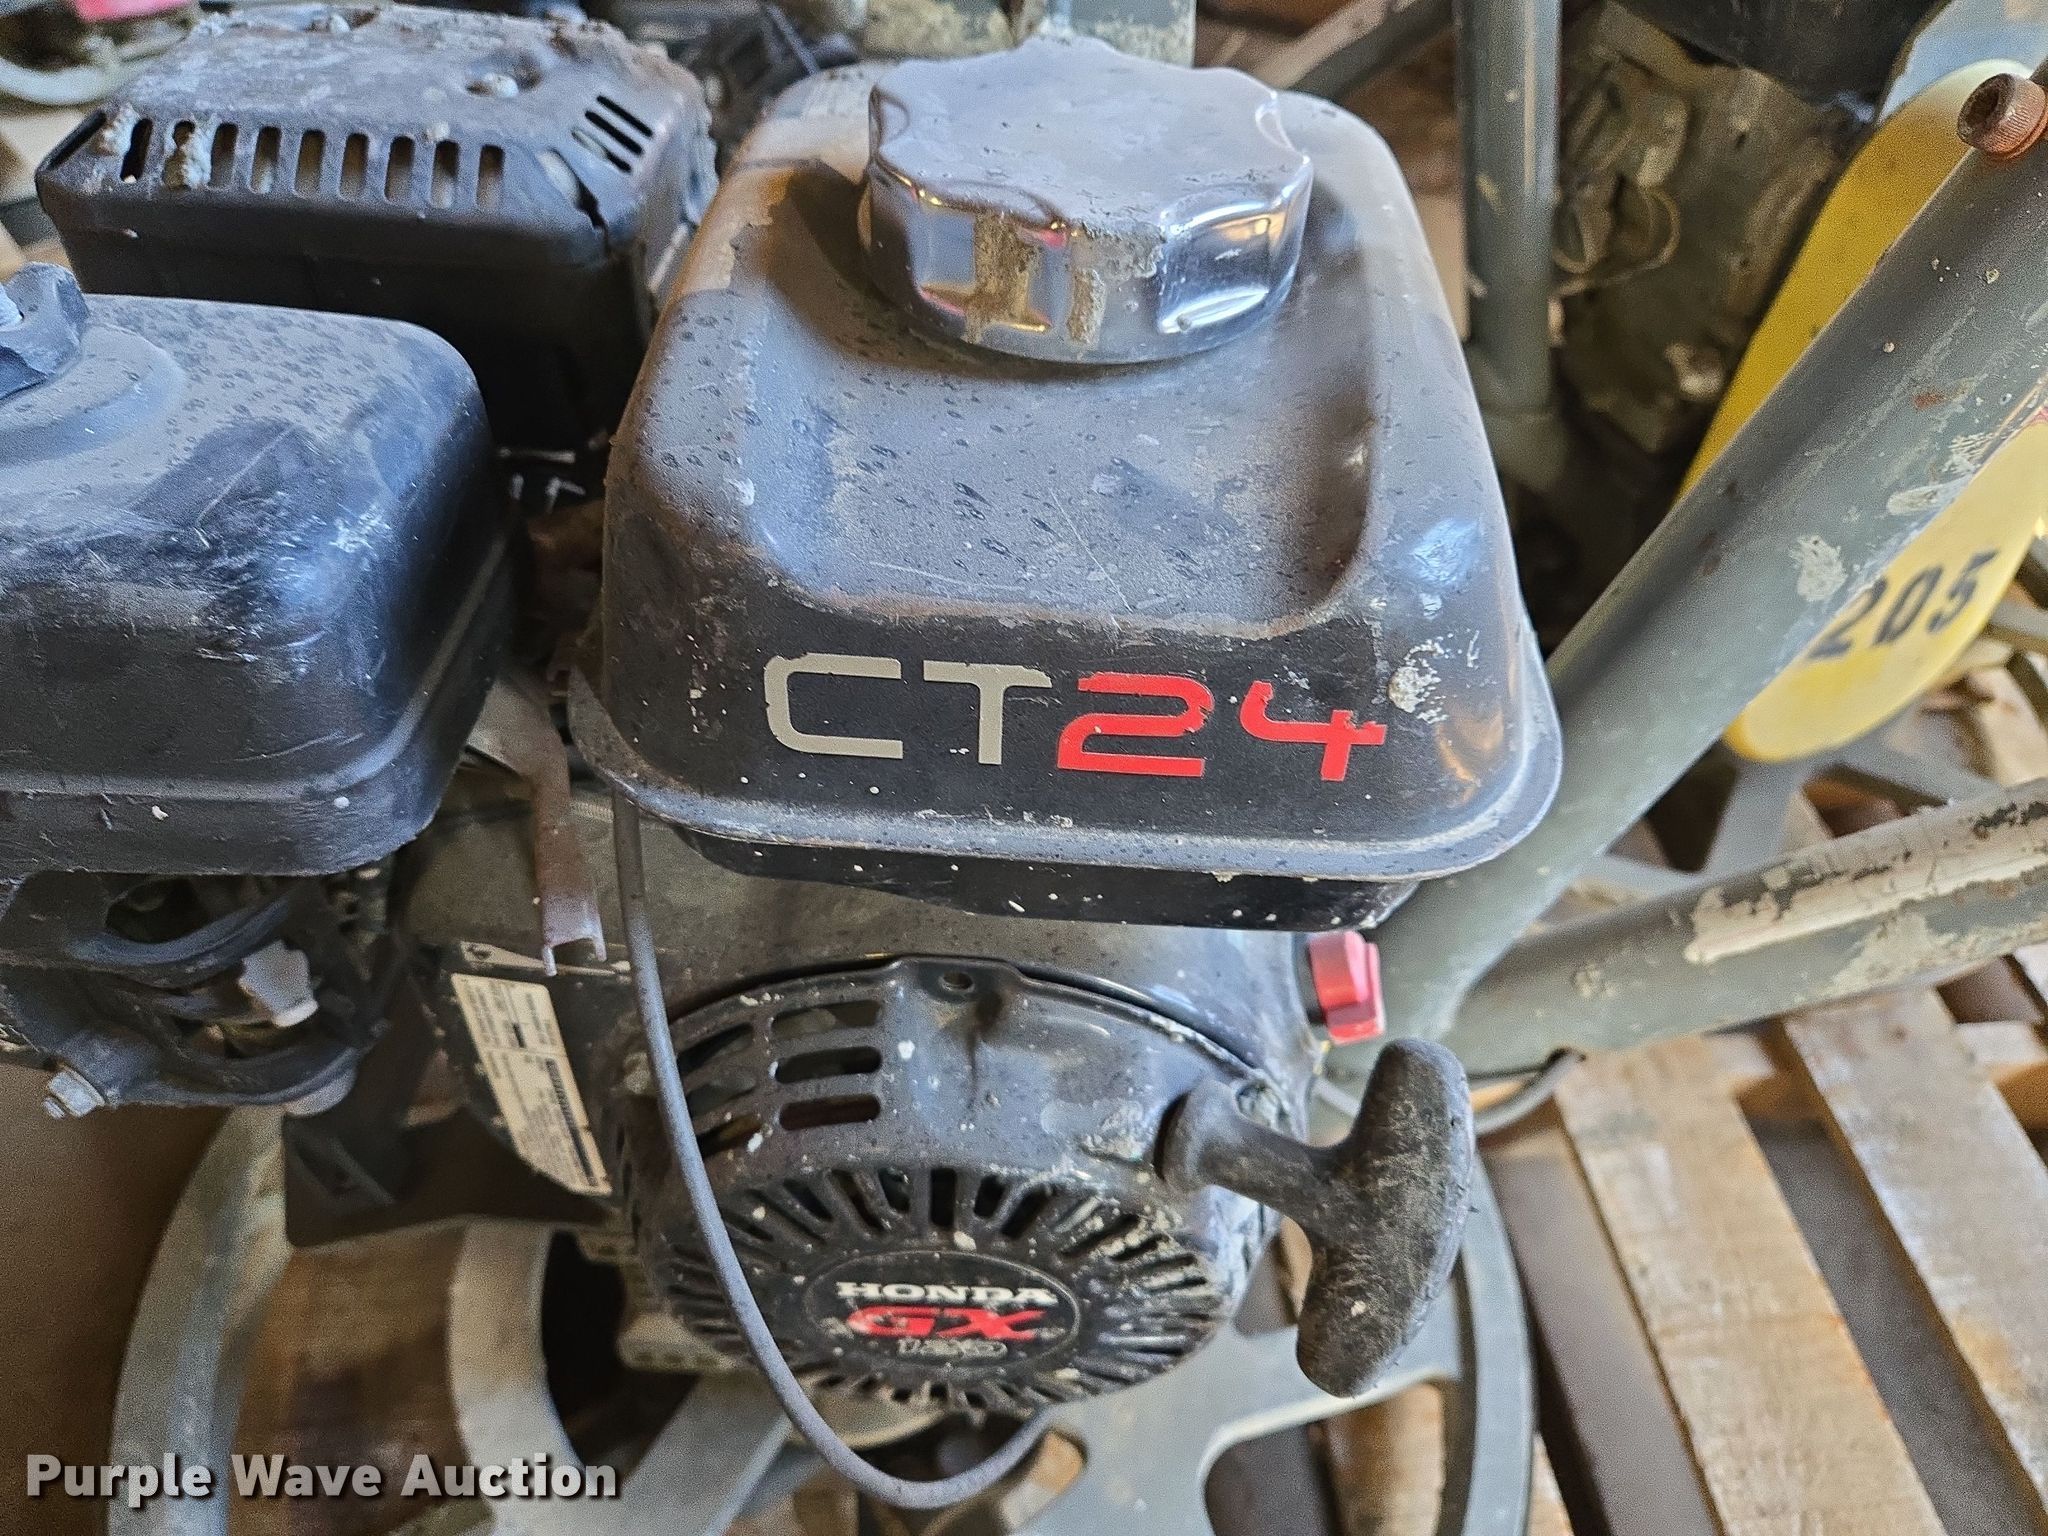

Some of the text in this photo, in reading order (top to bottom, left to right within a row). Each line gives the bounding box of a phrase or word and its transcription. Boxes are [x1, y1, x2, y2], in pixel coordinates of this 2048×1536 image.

[764, 652, 1386, 781] CT24
[836, 1281, 1058, 1305] HONDA
[847, 1305, 1047, 1342] GX
